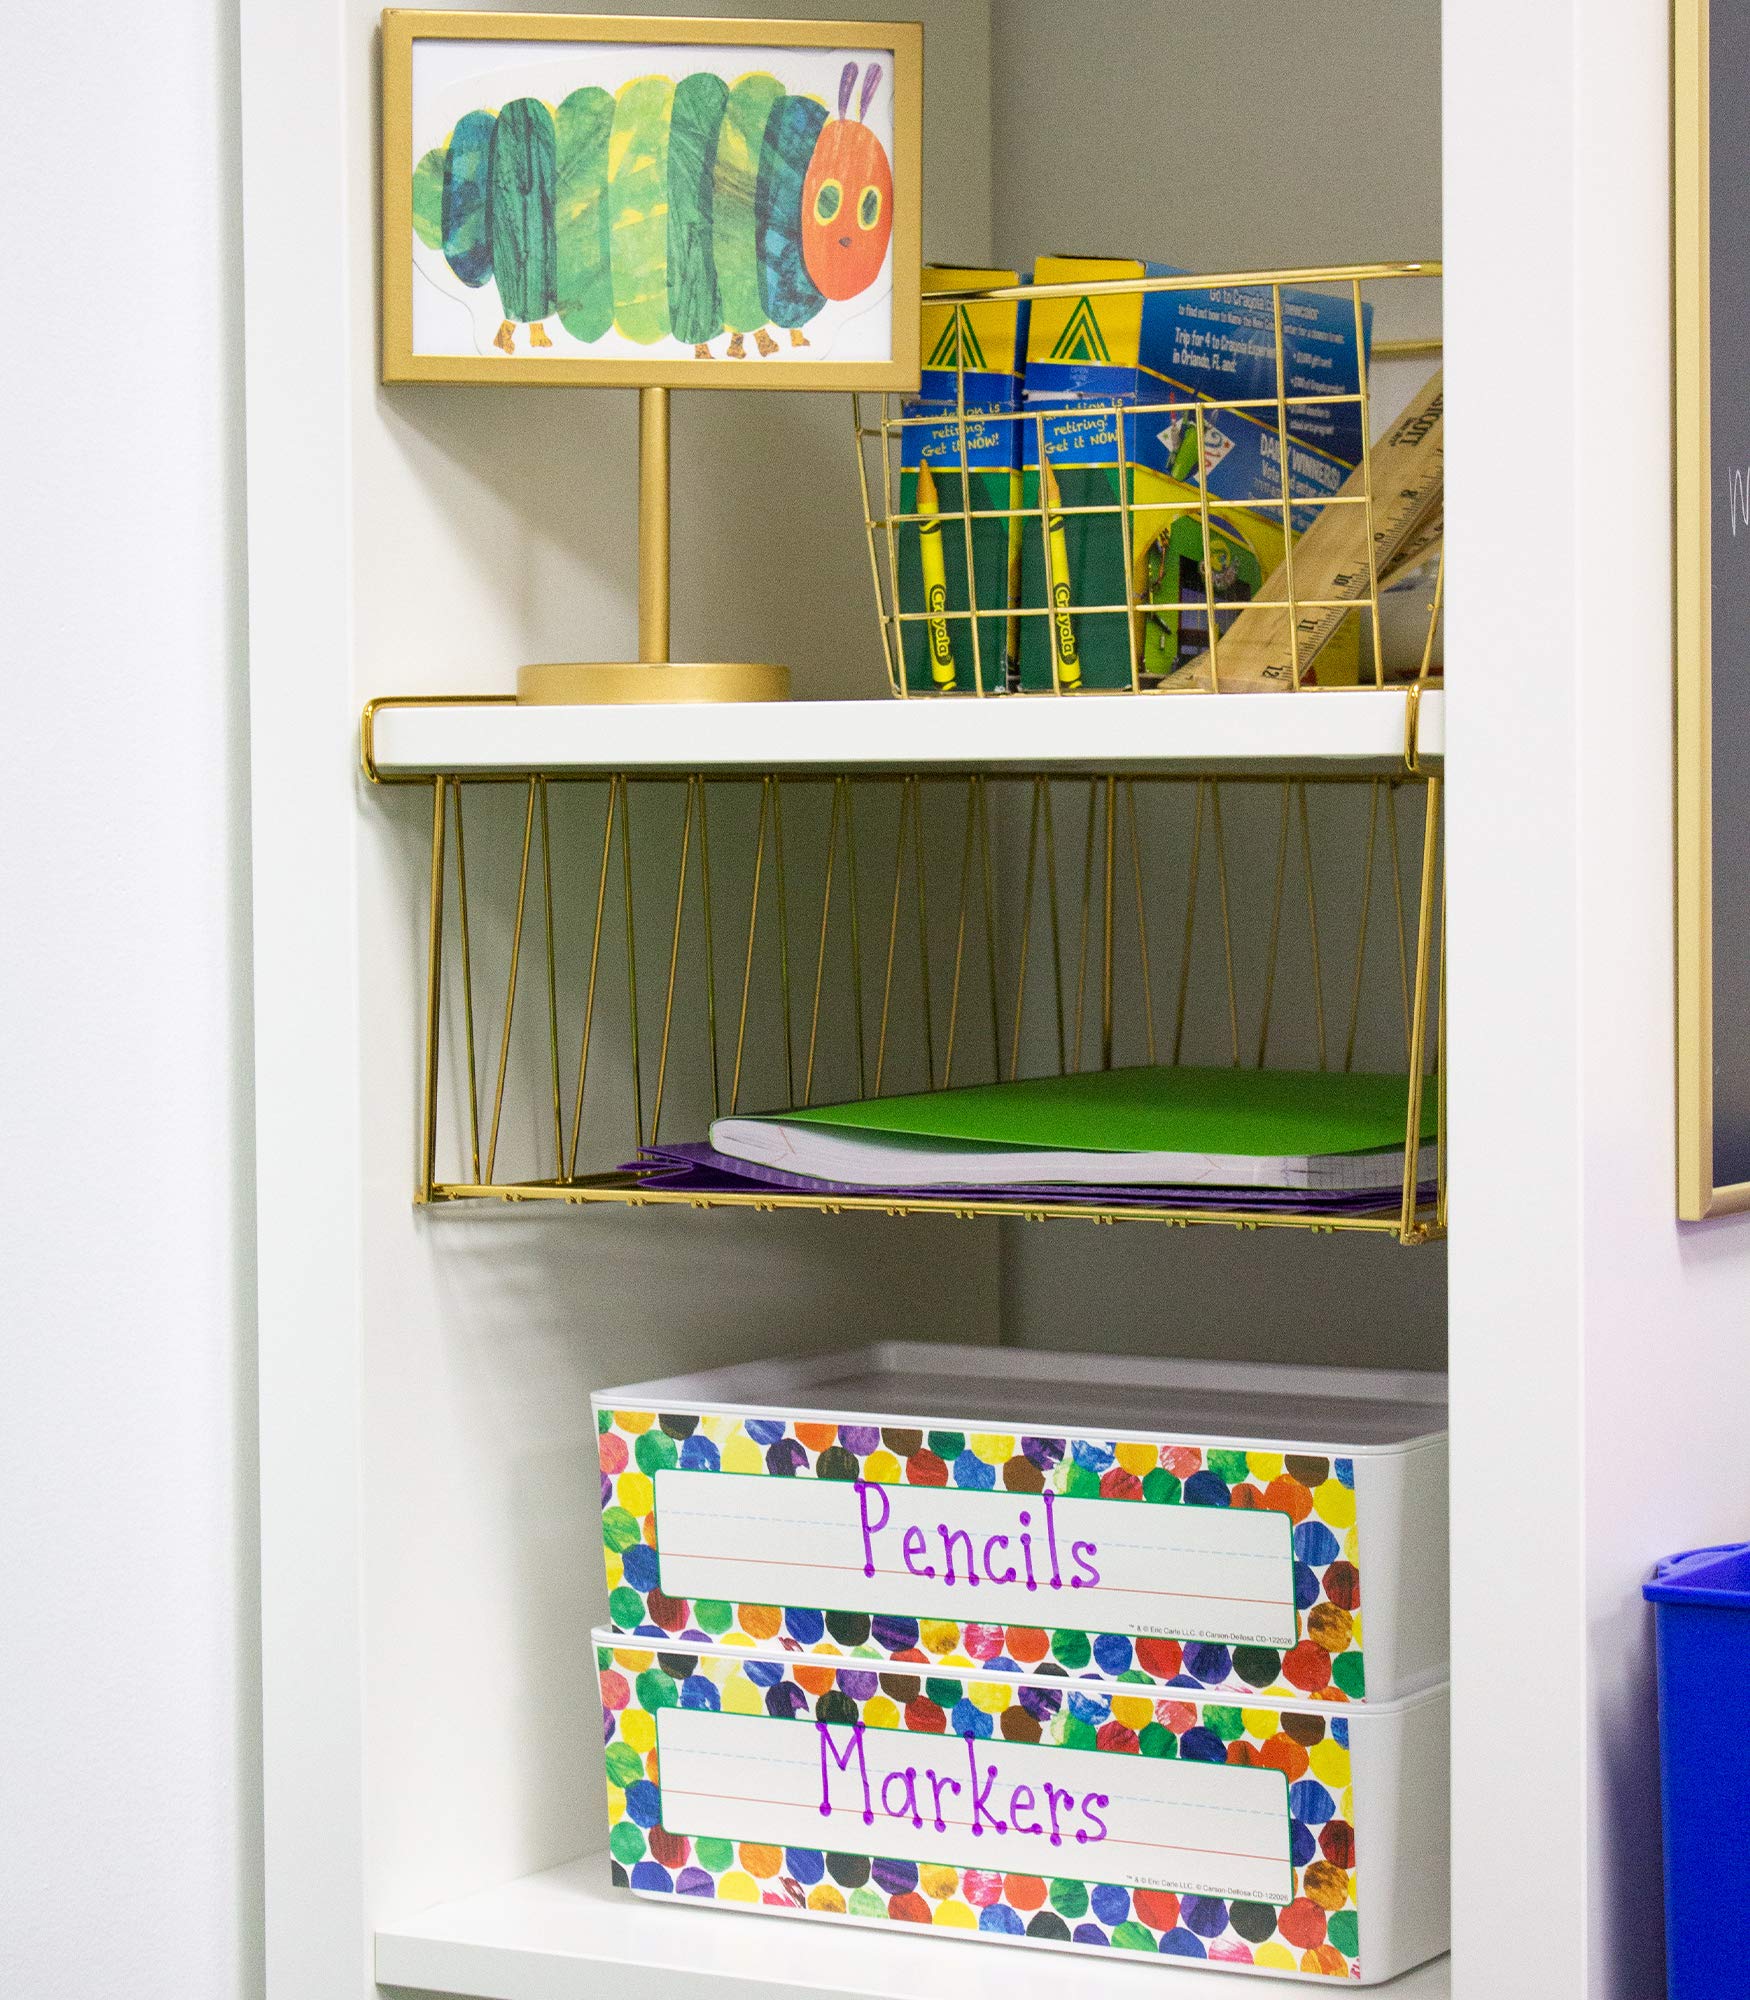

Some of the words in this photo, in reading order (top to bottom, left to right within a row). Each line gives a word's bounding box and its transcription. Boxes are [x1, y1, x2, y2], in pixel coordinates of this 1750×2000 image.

[1174, 326, 1190, 349] Trip
[1192, 329, 1204, 347] for
[1205, 331, 1211, 347] 4
[1212, 333, 1220, 350] to
[1172, 348, 1180, 364] in
[932, 420, 985, 440] retirng!
[1053, 414, 1108, 437] retiring!
[921, 442, 946, 457] Get
[1044, 438, 1069, 454] Get
[1073, 435, 1085, 449] it
[931, 588, 950, 657] Cryola
[1055, 587, 1075, 657] Cryola
[1296, 618, 1319, 633] 11
[1261, 664, 1284, 681] 12
[854, 1478, 1101, 1591] Pencils
[1150, 1625, 1162, 1633] Eric
[815, 1721, 1110, 1846] Markers
